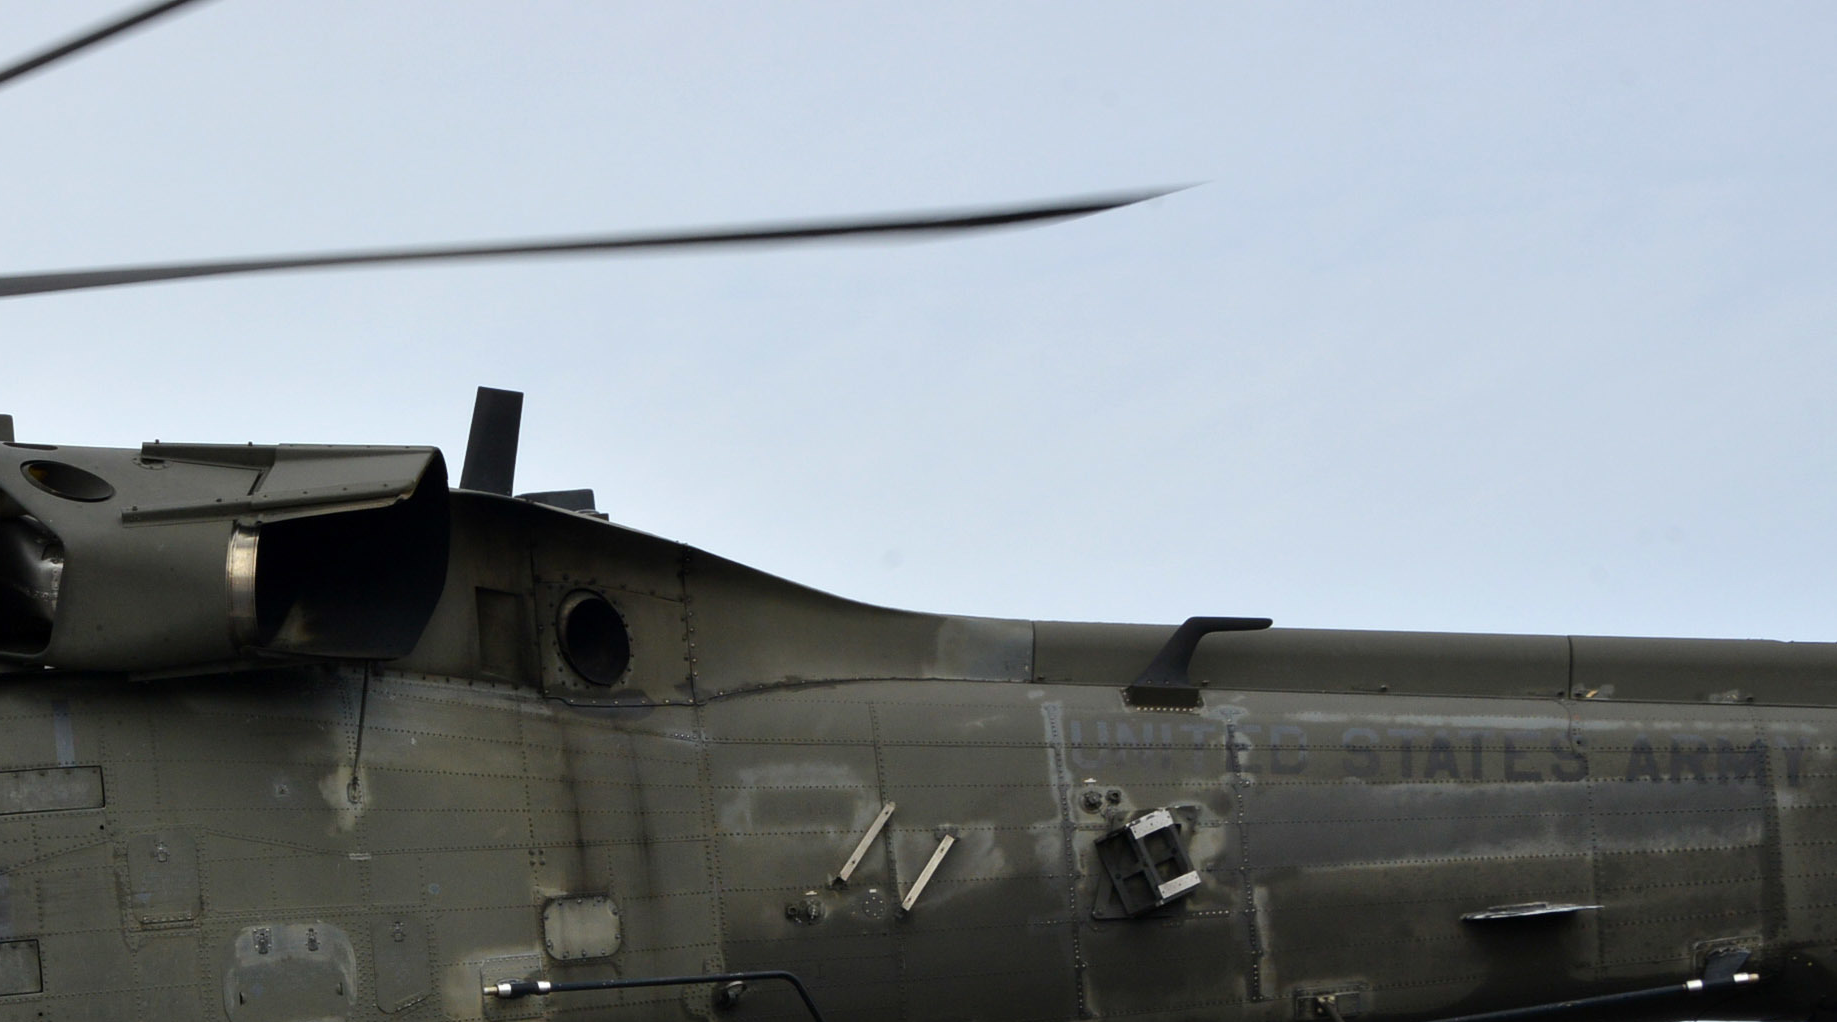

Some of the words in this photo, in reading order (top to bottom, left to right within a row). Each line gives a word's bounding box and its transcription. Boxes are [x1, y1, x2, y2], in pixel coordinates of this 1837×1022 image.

[1070, 718, 1309, 777] UNITED
[1342, 727, 1588, 783] STATES
[1625, 734, 1809, 786] ARMY
